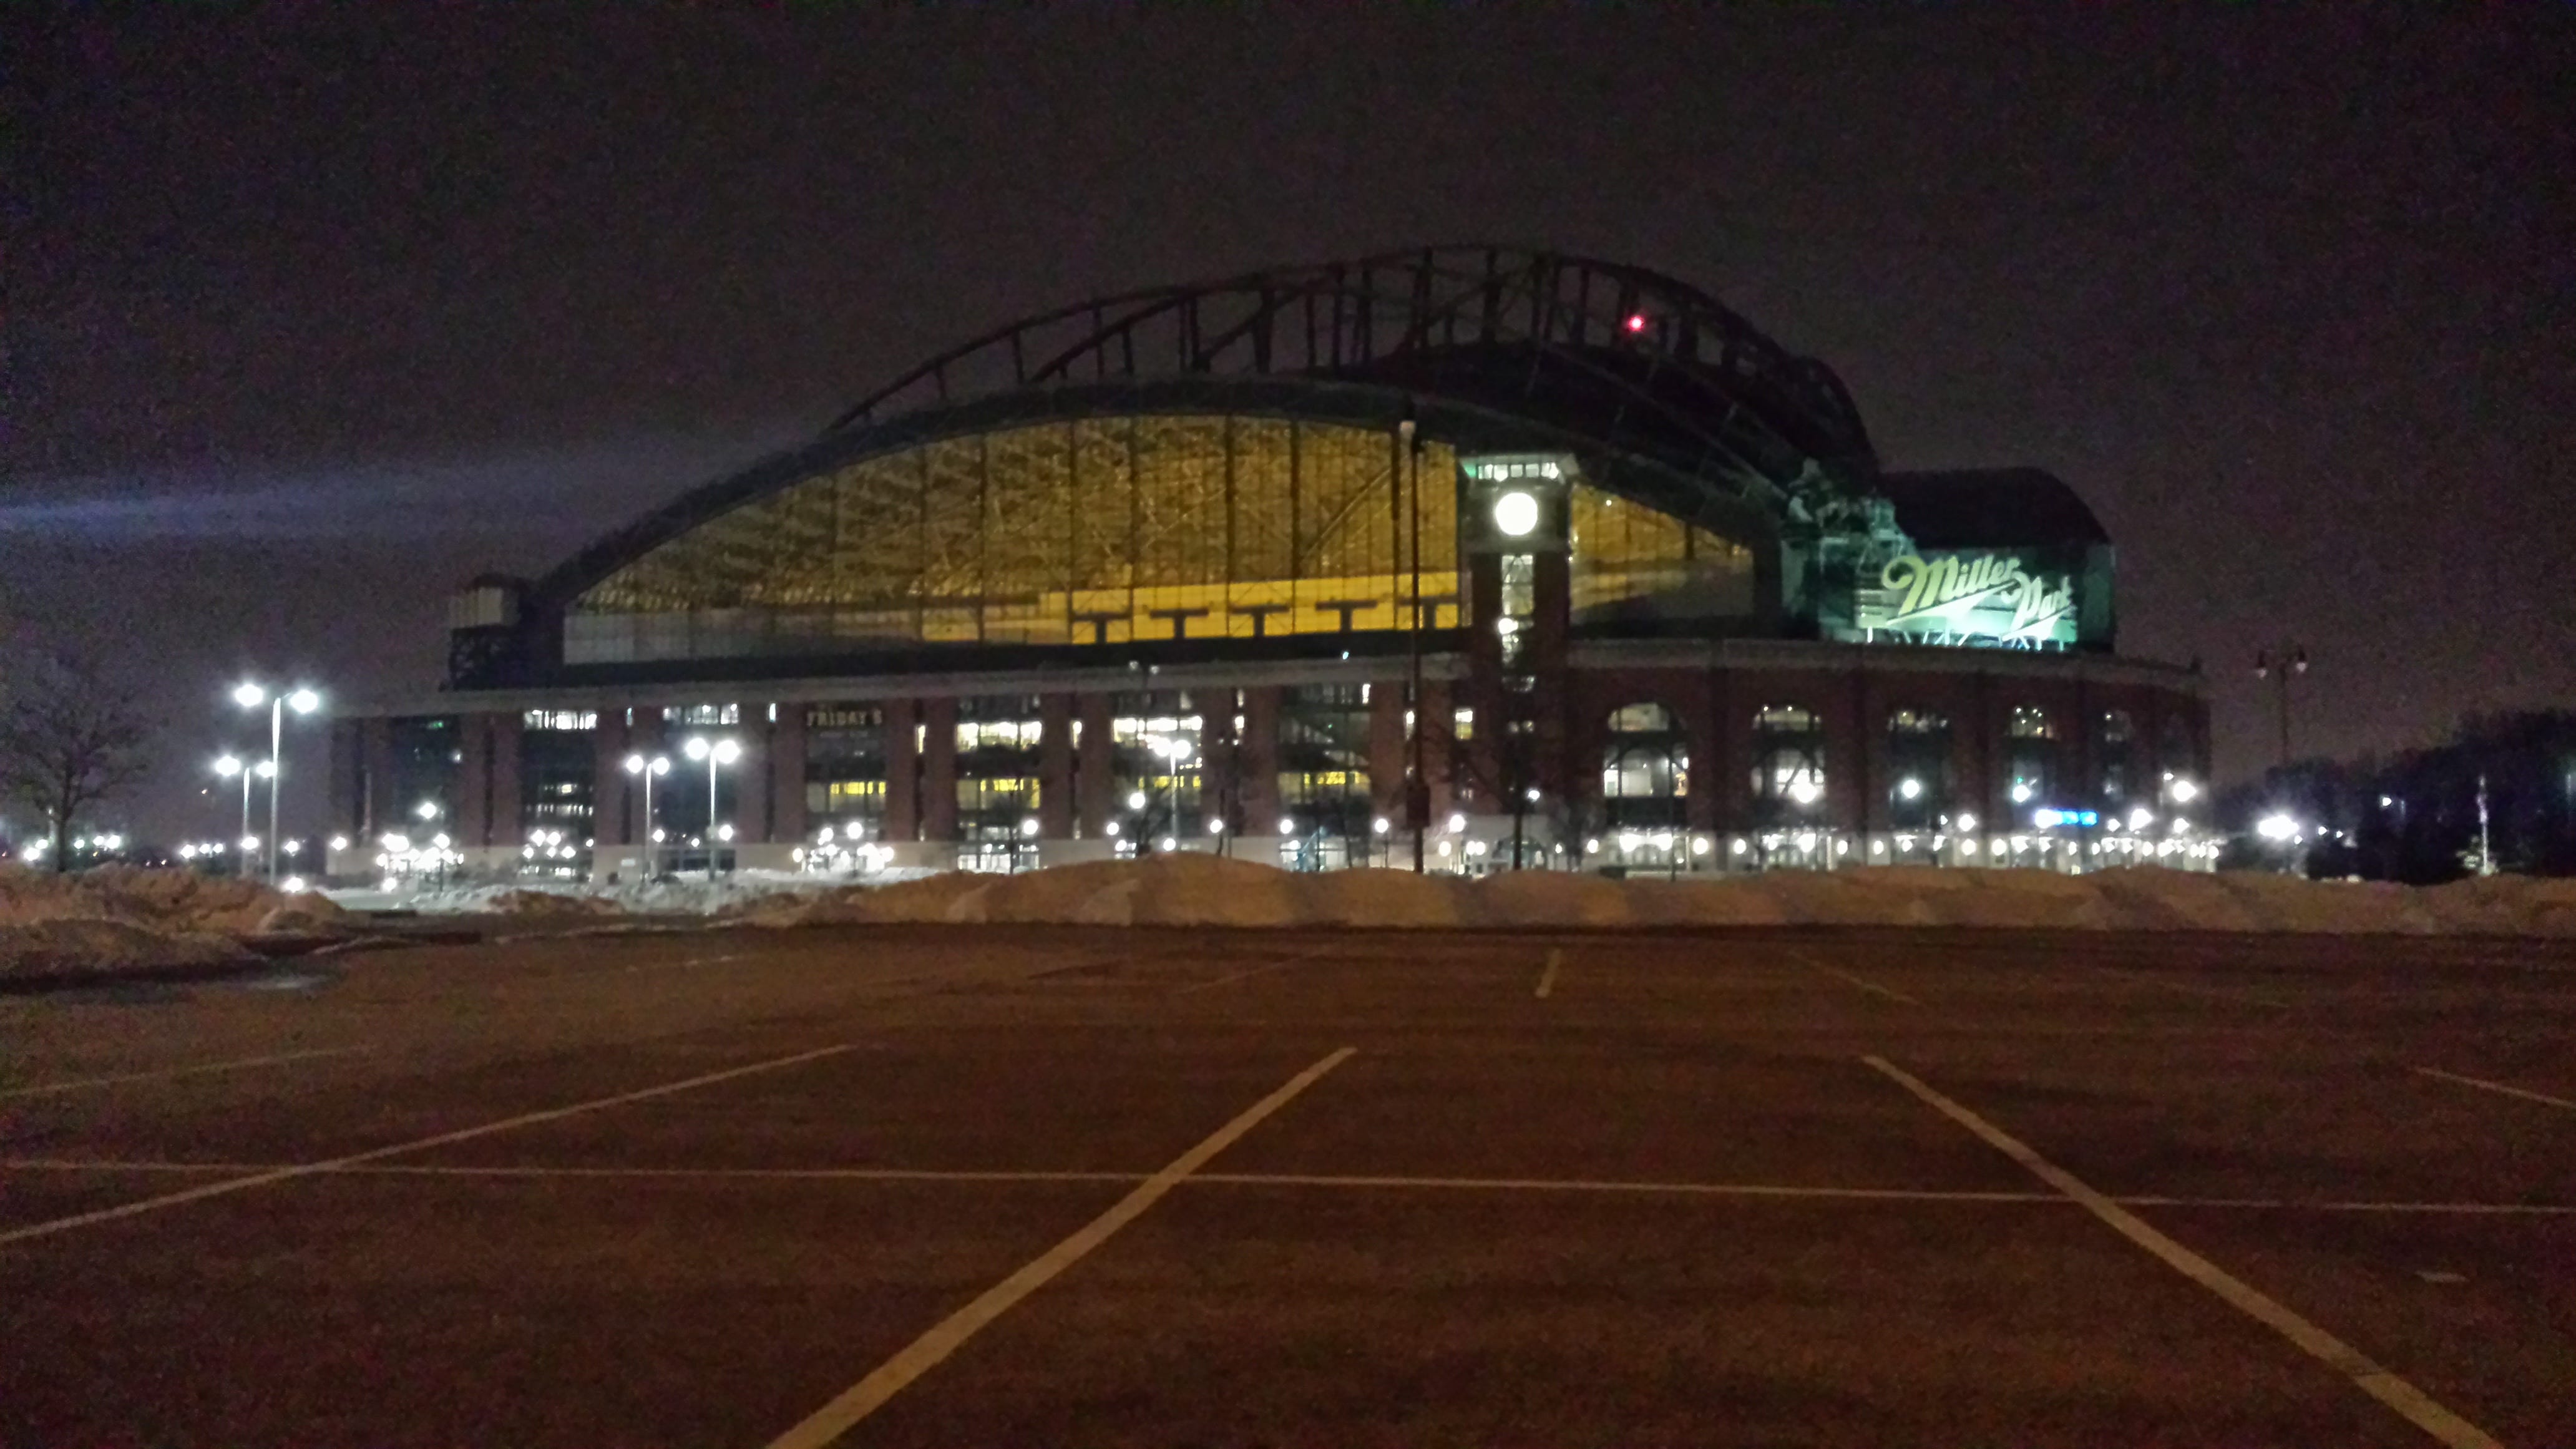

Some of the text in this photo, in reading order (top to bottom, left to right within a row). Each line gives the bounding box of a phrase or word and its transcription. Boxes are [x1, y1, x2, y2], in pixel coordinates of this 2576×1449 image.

[1881, 555, 2072, 629] Miller Park
[807, 710, 882, 726] FRIDAYS
